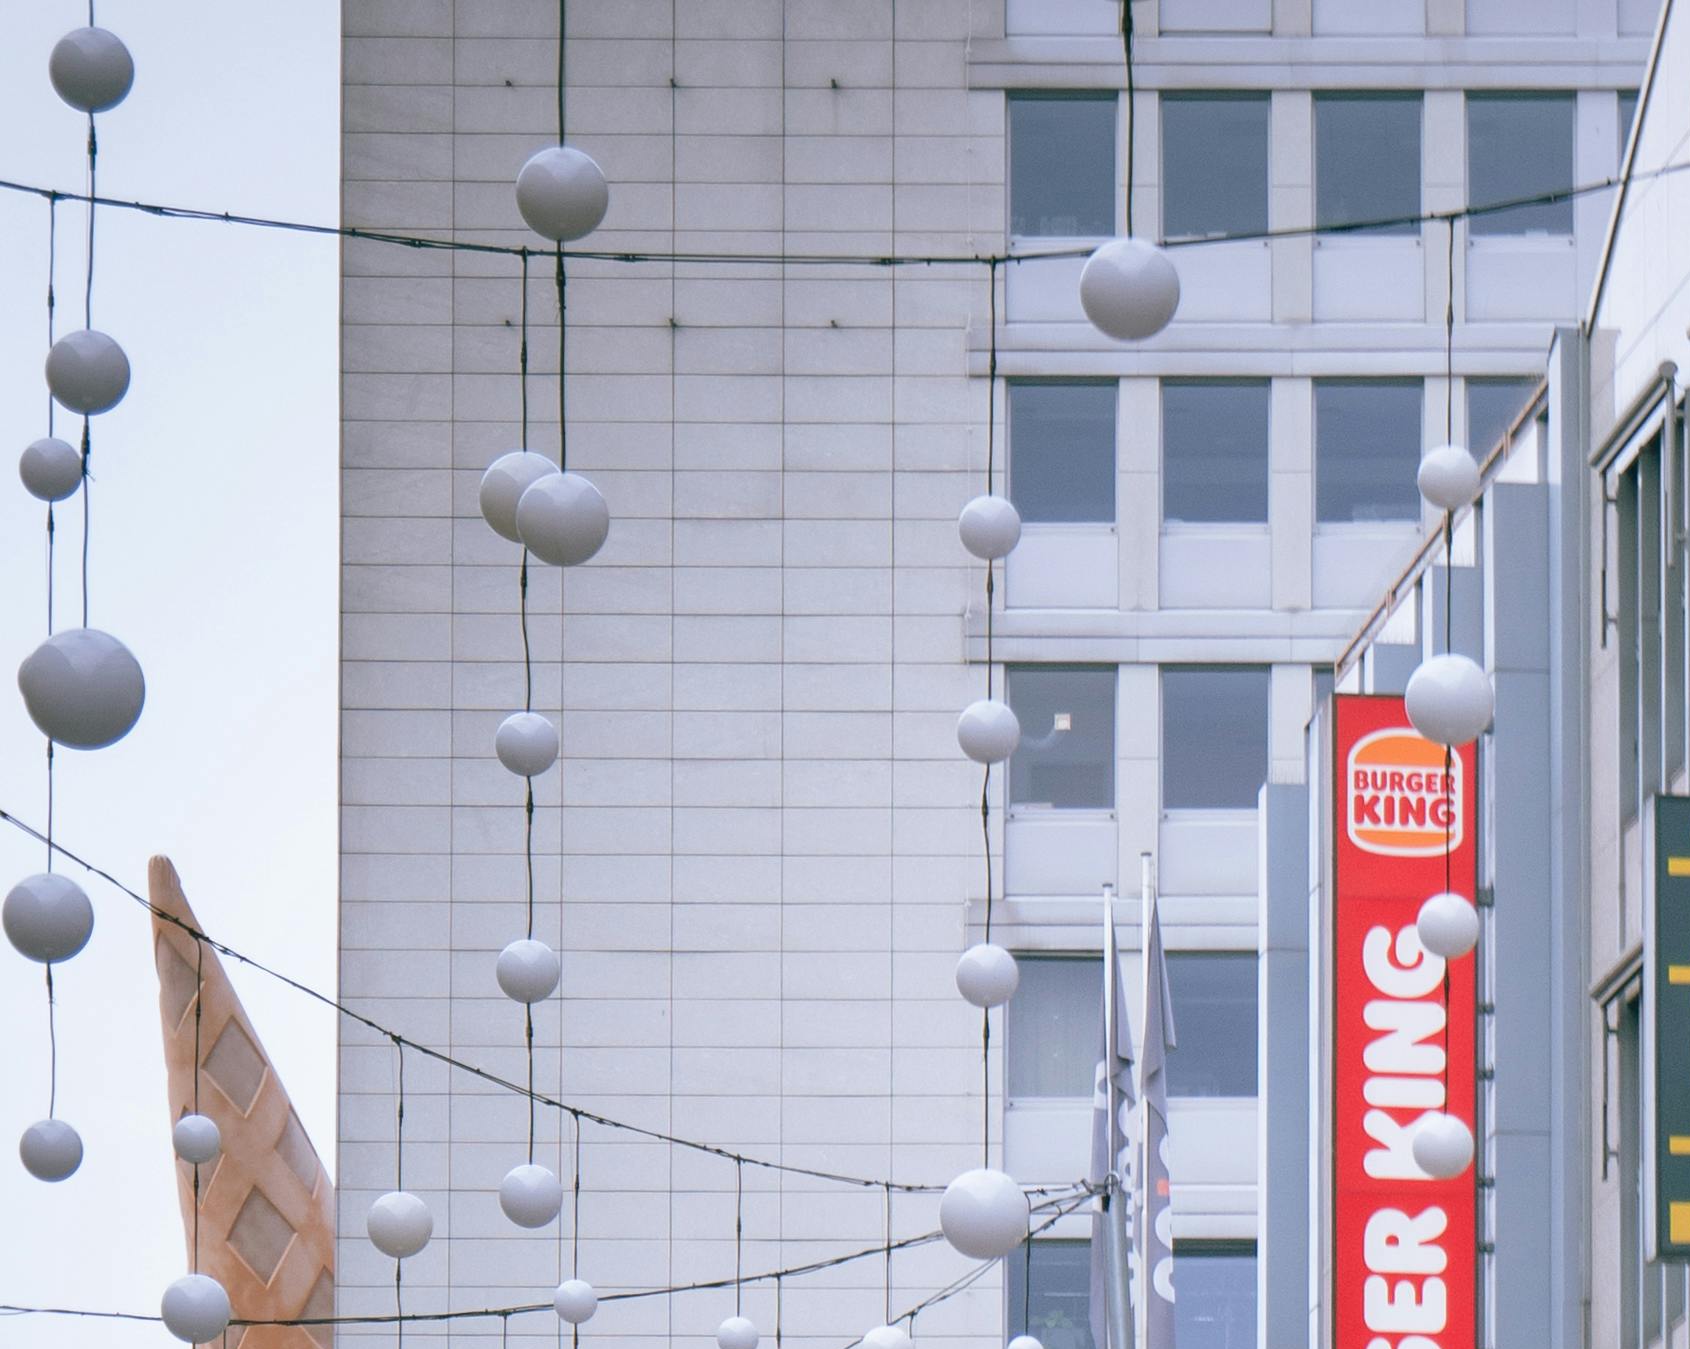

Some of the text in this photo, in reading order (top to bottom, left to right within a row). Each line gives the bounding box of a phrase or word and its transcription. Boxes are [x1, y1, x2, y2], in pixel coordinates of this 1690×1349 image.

[1353, 769, 1456, 795] BURGER
[1353, 794, 1456, 828] KING
[1362, 922, 1447, 1181] KING
